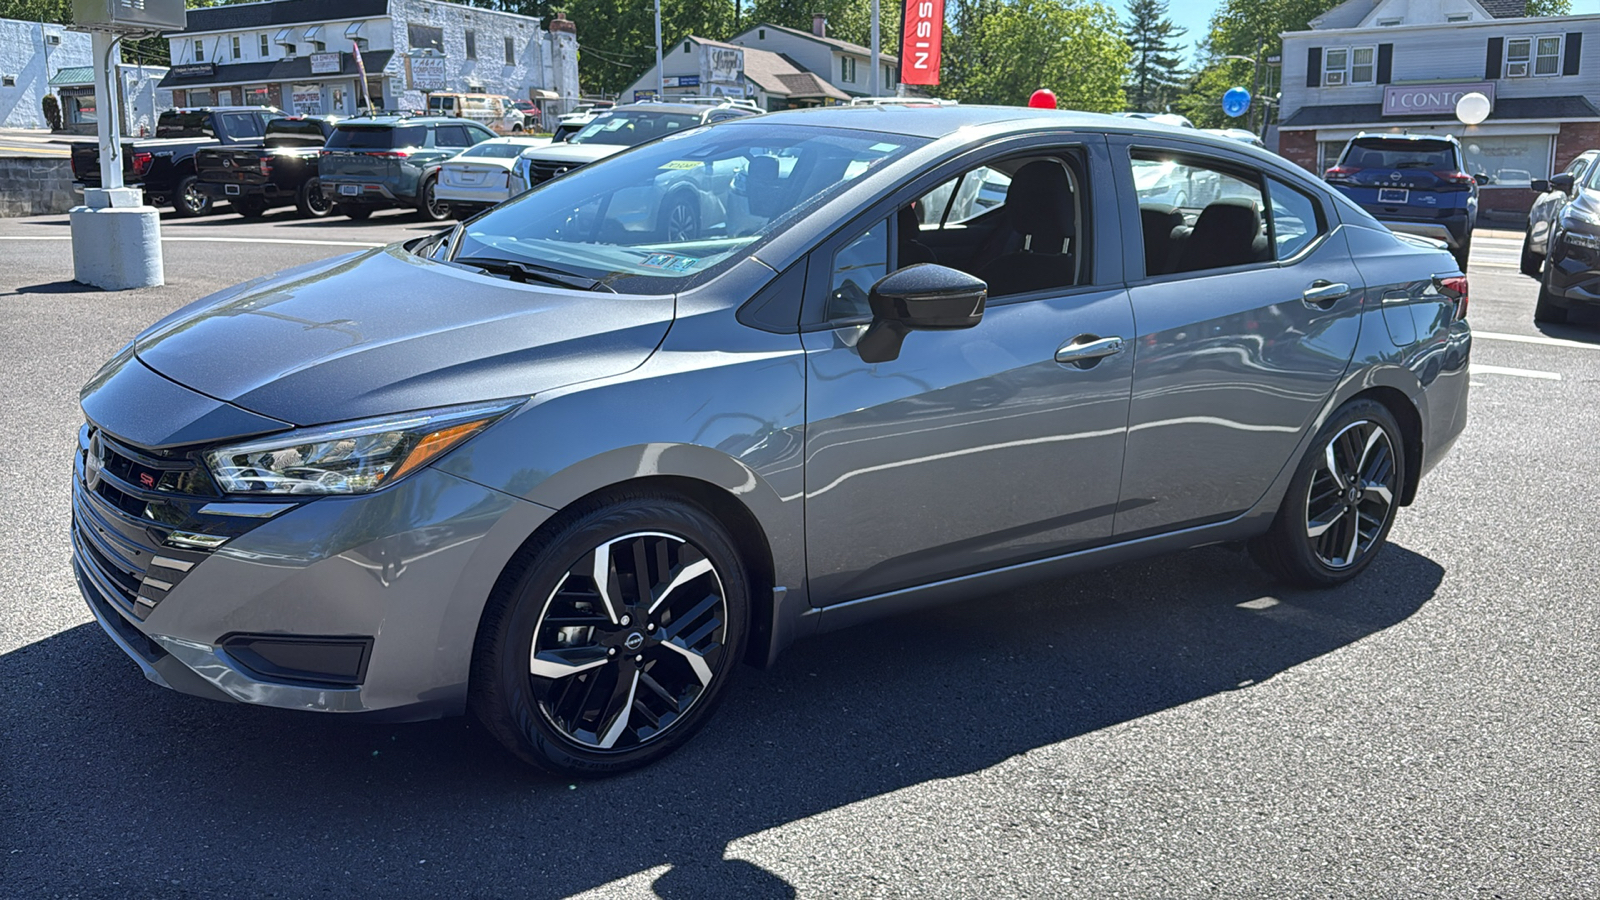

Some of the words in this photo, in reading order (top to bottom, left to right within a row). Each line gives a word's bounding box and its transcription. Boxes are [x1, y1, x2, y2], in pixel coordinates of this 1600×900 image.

[413, 66, 444, 74] COMPUTERS
[293, 93, 320, 102] COMPUTERS
[1401, 92, 1487, 107] CONTO
[140, 472, 154, 487] SR
